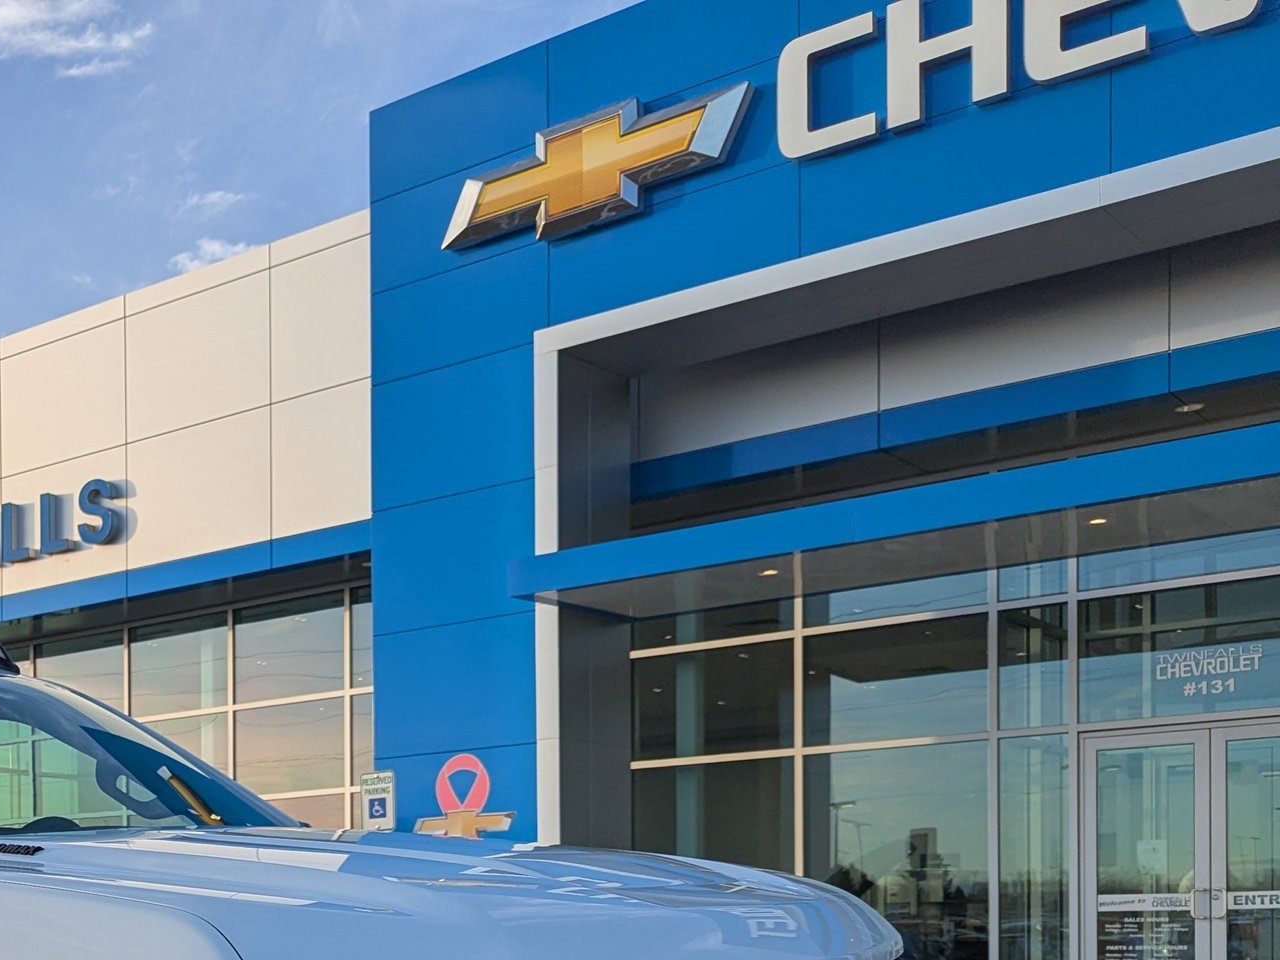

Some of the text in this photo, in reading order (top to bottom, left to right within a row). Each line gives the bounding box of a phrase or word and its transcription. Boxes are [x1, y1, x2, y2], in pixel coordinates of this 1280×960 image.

[777, 0, 1261, 161] CHE
[1156, 654, 1263, 680] CHEVROLET
[1183, 678, 1236, 697] #131
[361, 776, 391, 786] RESERVED
[364, 787, 390, 795] PARKING
